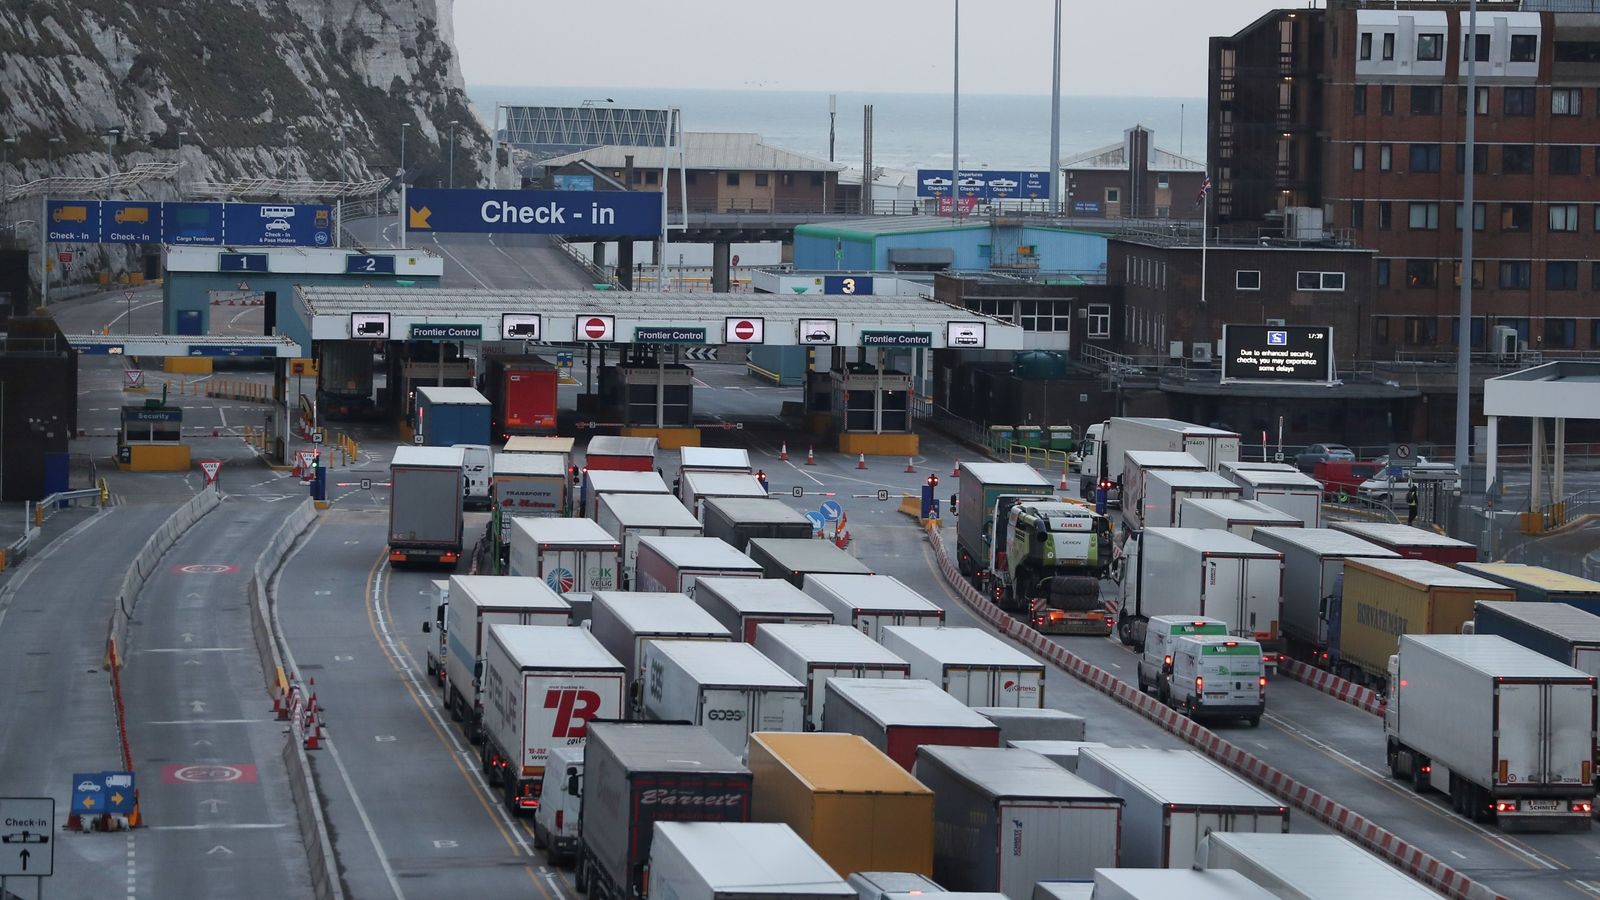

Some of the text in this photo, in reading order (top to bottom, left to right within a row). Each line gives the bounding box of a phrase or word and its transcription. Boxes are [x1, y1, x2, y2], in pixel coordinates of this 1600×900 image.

[480, 200, 566, 224] Check
[591, 202, 615, 224] in
[240, 256, 248, 269] 1
[366, 258, 375, 271] 2
[842, 278, 856, 294] 3
[672, 332, 704, 340] Control
[864, 335, 930, 344] Frontier Control
[138, 412, 169, 420] Security
[641, 789, 741, 806] Barrett
[5, 818, 47, 827] Check-in
